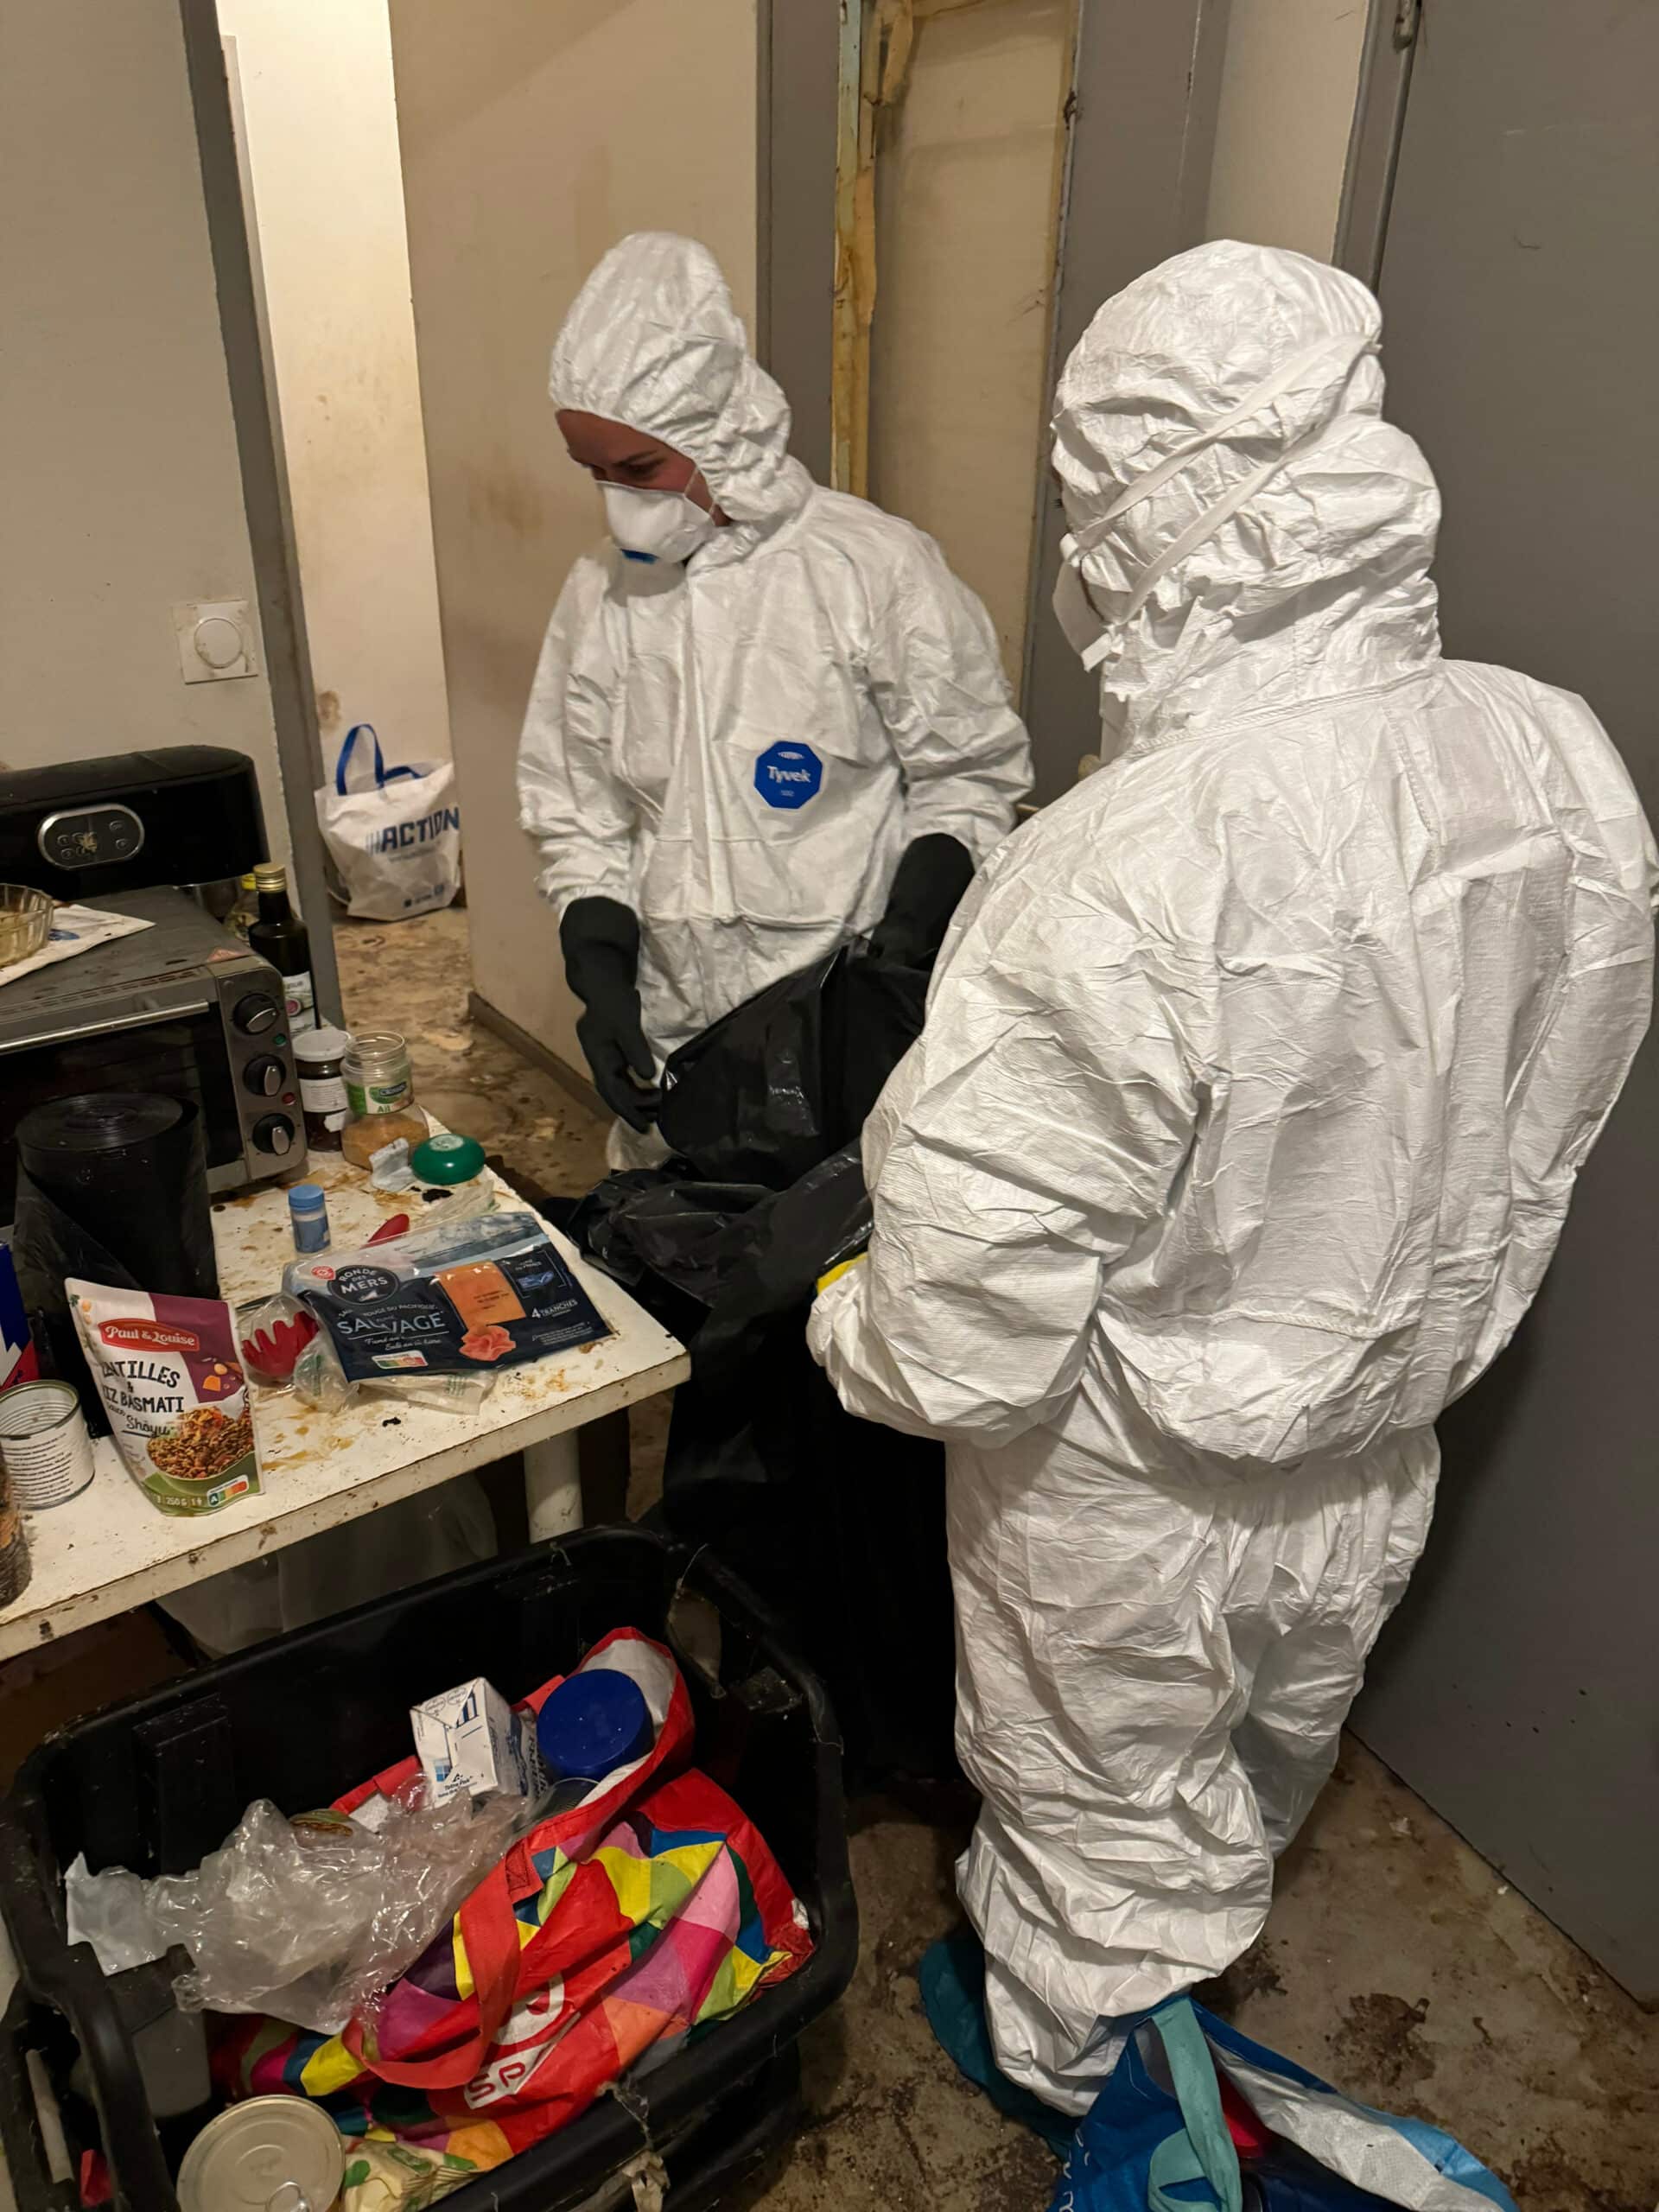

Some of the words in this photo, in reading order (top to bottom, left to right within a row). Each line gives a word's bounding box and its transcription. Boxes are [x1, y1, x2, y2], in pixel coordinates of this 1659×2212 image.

[767, 766, 811, 784] Tyvek
[381, 807, 460, 852] ACTION
[338, 1268, 378, 1281] RONDE
[340, 1277, 388, 1294] MERS
[531, 1307, 541, 1319] 4
[541, 1299, 578, 1316] TRANCHES
[105, 1325, 139, 1339] Paul
[141, 1330, 151, 1338] &
[151, 1330, 195, 1346] Louise
[120, 1391, 185, 1413] BASMATI
[467, 2063, 525, 2101] SP
